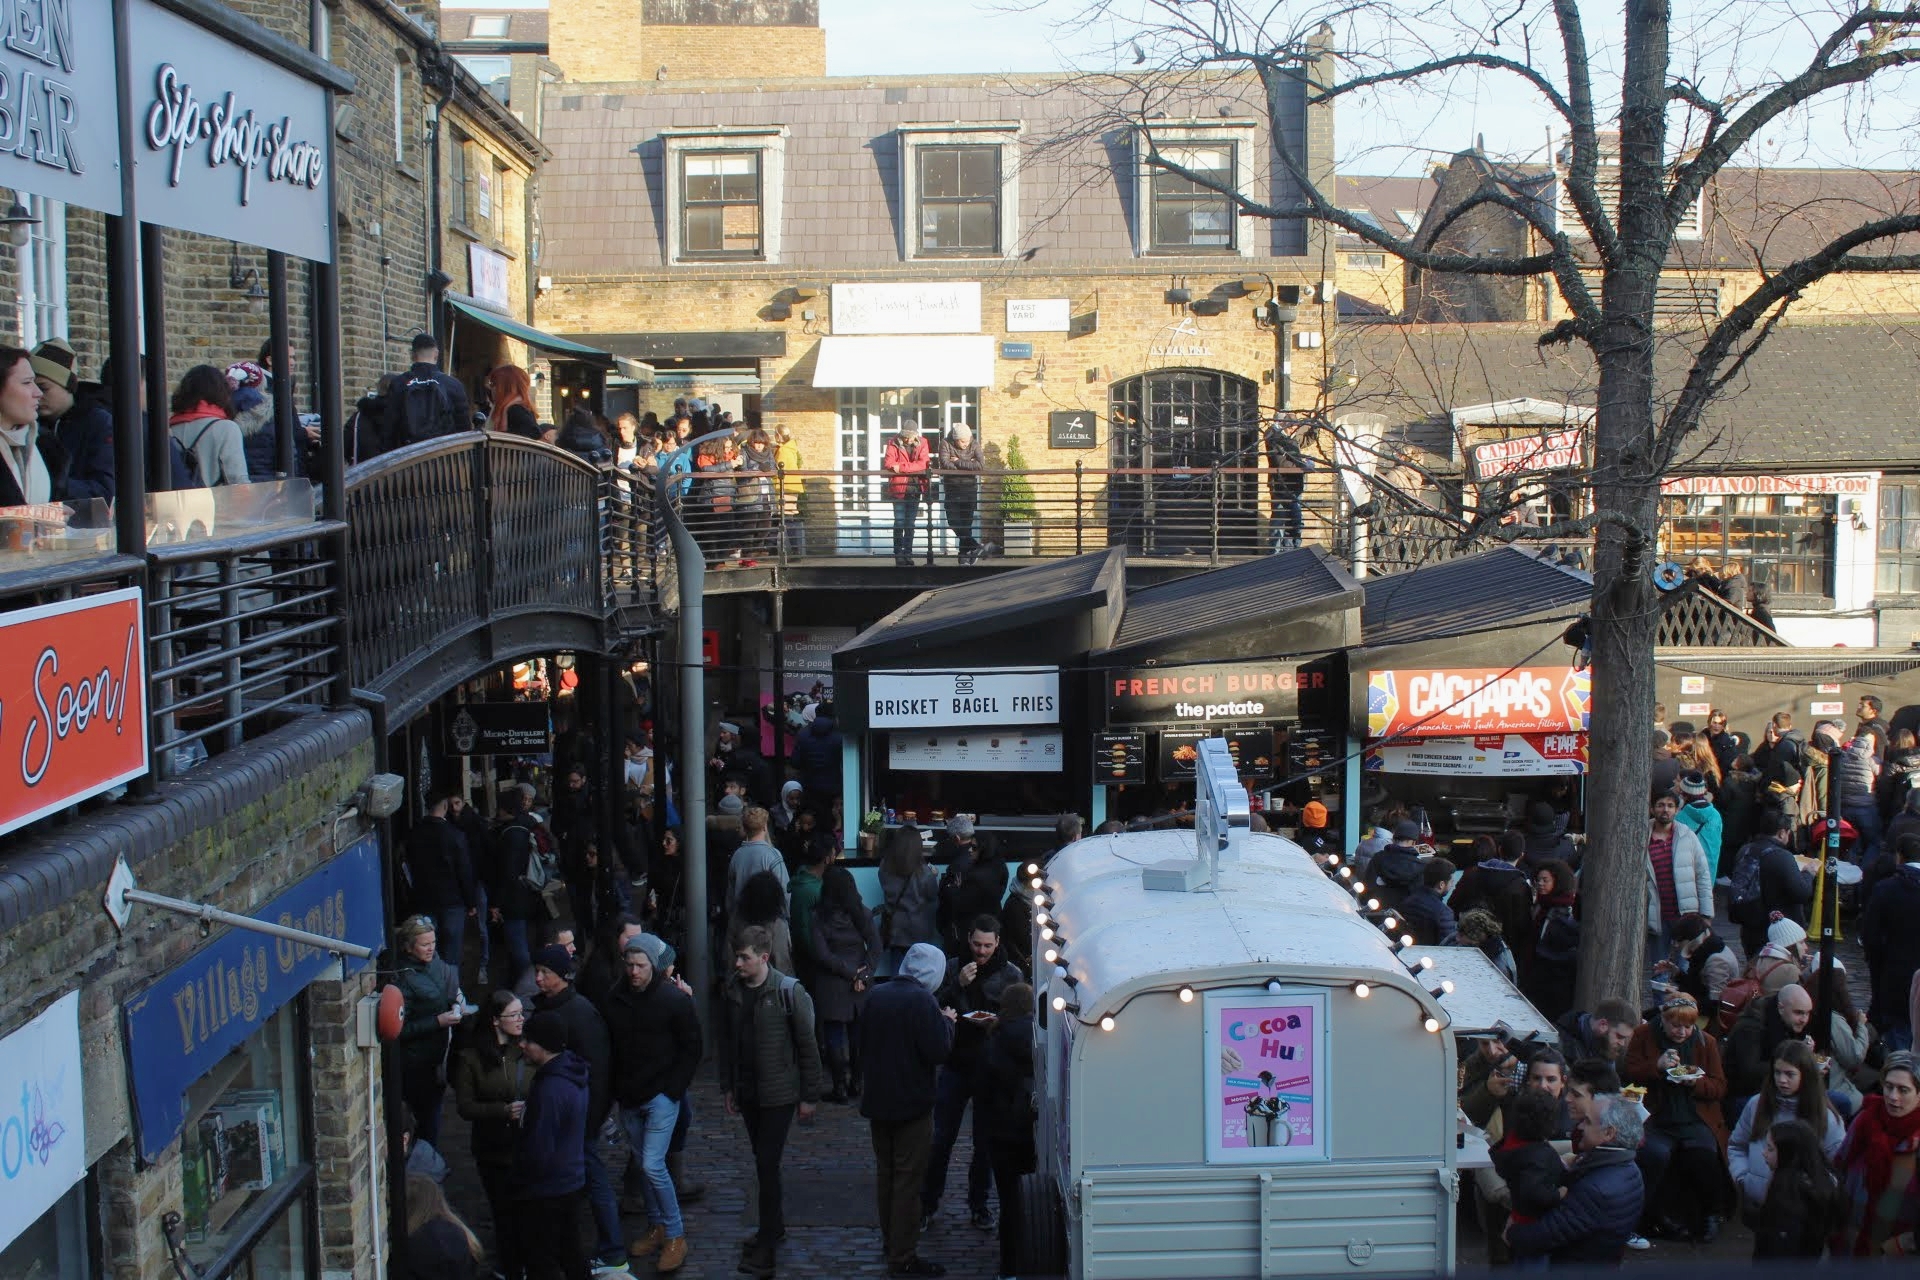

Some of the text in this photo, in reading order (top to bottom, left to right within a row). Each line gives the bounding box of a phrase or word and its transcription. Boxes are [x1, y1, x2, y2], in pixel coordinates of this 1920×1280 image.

[1476, 437, 1542, 461] CAMDEN
[1695, 476, 1756, 493] PIANO
[1759, 476, 1870, 494] RESCUE.COM
[784, 642, 833, 651] in Camden
[784, 659, 797, 667] for
[798, 659, 805, 667] 2
[1115, 672, 1325, 697] FRENCH BURGER
[1409, 671, 1552, 719] CACHAPAS
[21, 624, 134, 787] Soon!
[875, 696, 1053, 716] BRISKET BAGEL FRIES
[1175, 701, 1264, 720] the patate
[1416, 724, 1453, 735] pancakes
[1455, 722, 1471, 731] with
[1474, 720, 1494, 730] South
[1498, 719, 1536, 729] American
[1537, 717, 1564, 730] fillings
[1229, 1014, 1302, 1041] Cocoa
[1260, 1038, 1305, 1062] Hut
[1223, 1126, 1246, 1138] £4
